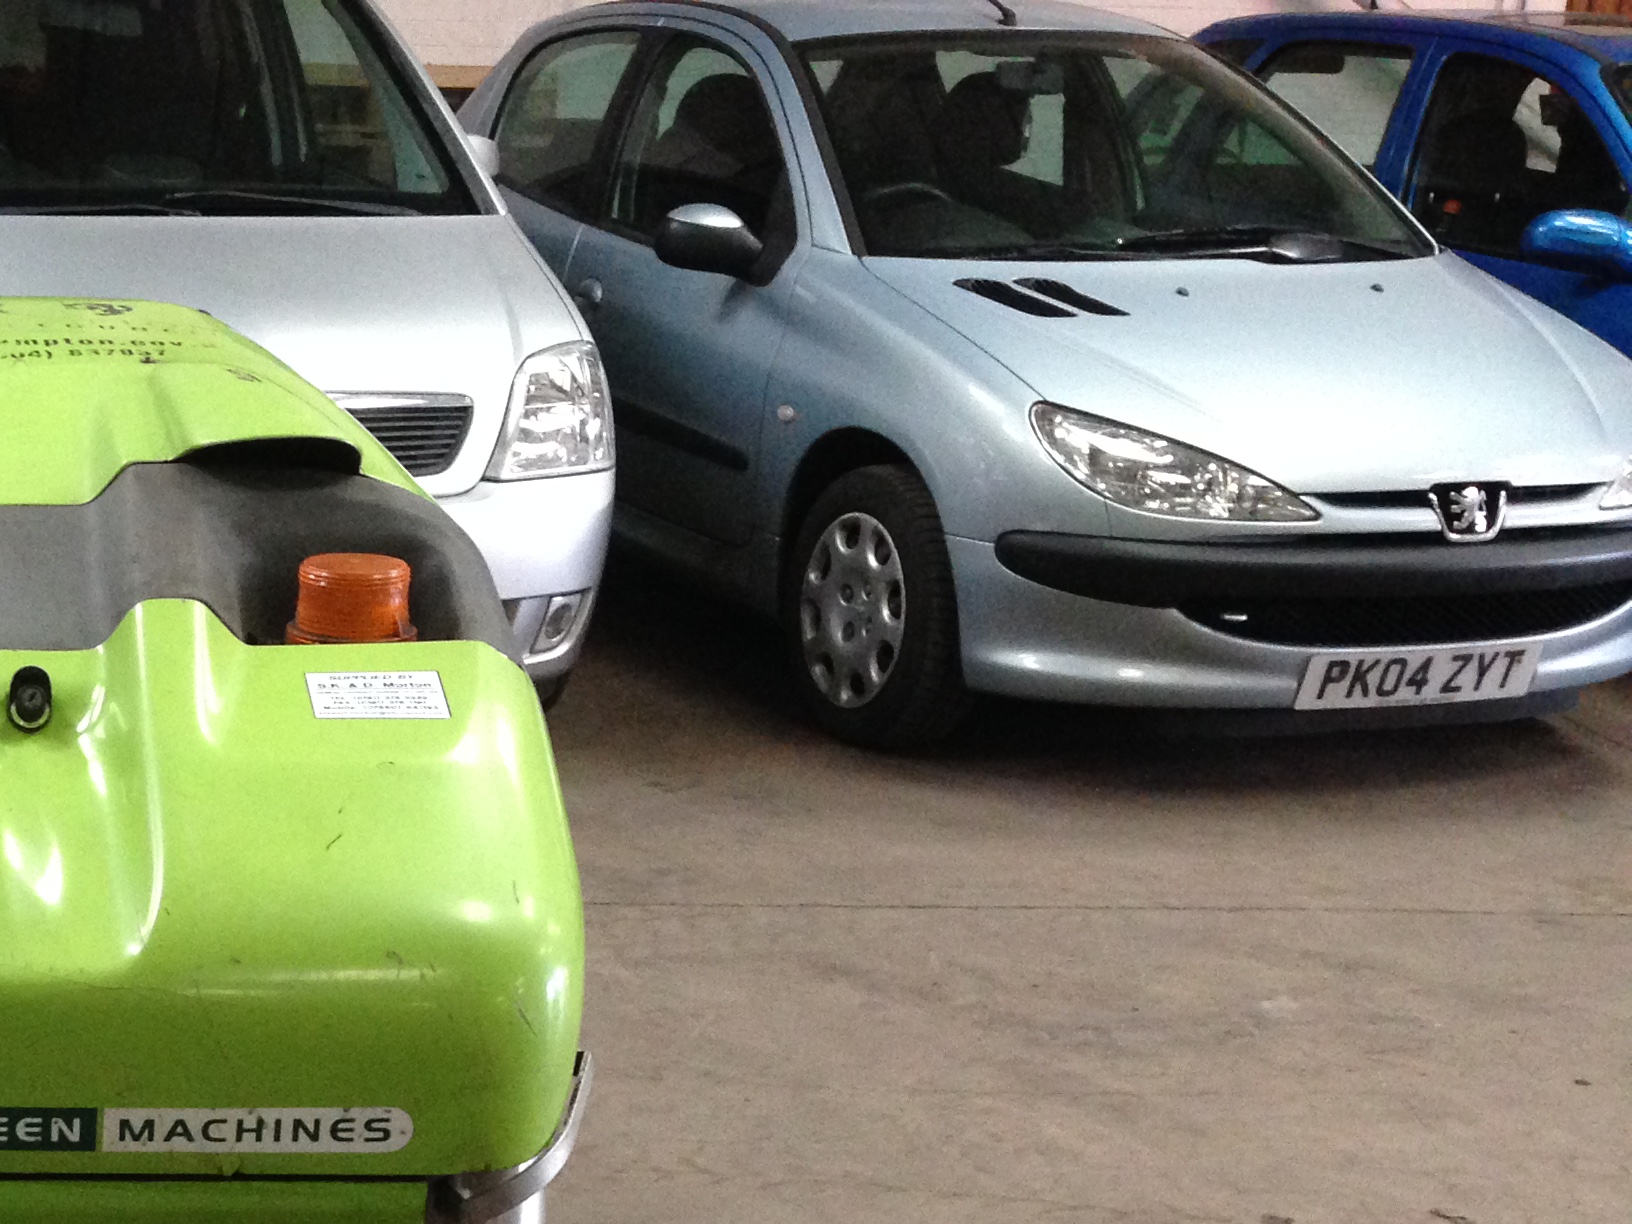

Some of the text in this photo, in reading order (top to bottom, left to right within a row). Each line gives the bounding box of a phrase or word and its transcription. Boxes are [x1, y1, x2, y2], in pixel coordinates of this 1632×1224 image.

[1317, 650, 1525, 700] PK04 ZYT
[118, 1116, 392, 1143] MACHINES
